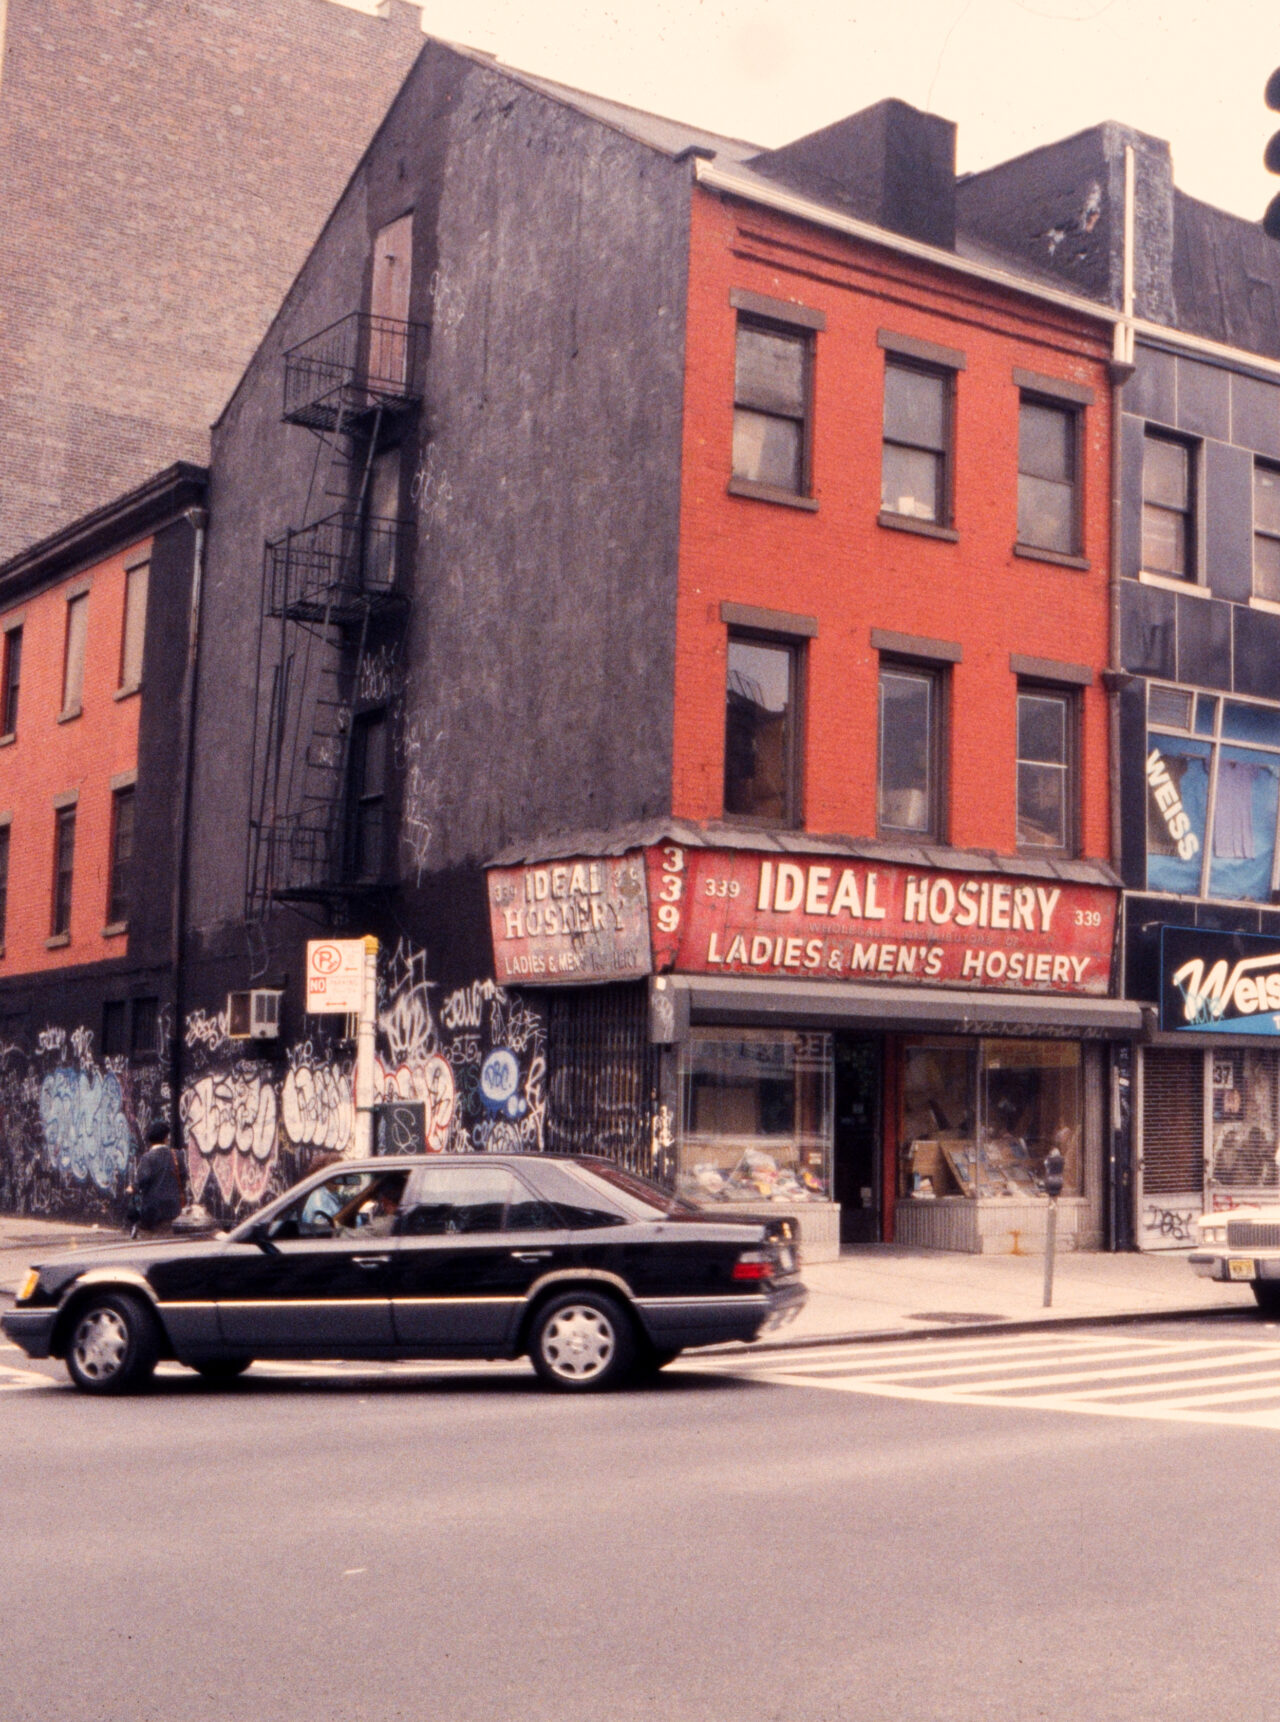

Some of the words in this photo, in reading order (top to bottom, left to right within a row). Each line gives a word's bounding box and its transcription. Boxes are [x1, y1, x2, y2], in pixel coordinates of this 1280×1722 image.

[1146, 749, 1199, 861] WEISS
[525, 863, 602, 903] IDEAL
[657, 847, 684, 932] 339
[705, 878, 740, 898] 339
[757, 861, 886, 919] IDEAL
[904, 875, 1061, 932] HOSIERY
[504, 900, 625, 939] HOSIERY
[1074, 909, 1101, 927] 339
[505, 956, 546, 975] LADIES
[549, 956, 558, 973] &
[707, 933, 824, 968] LADIES
[828, 949, 843, 972] &
[852, 943, 944, 975] MEN'S
[962, 949, 1091, 983] HOSIERY
[310, 978, 326, 993] NO
